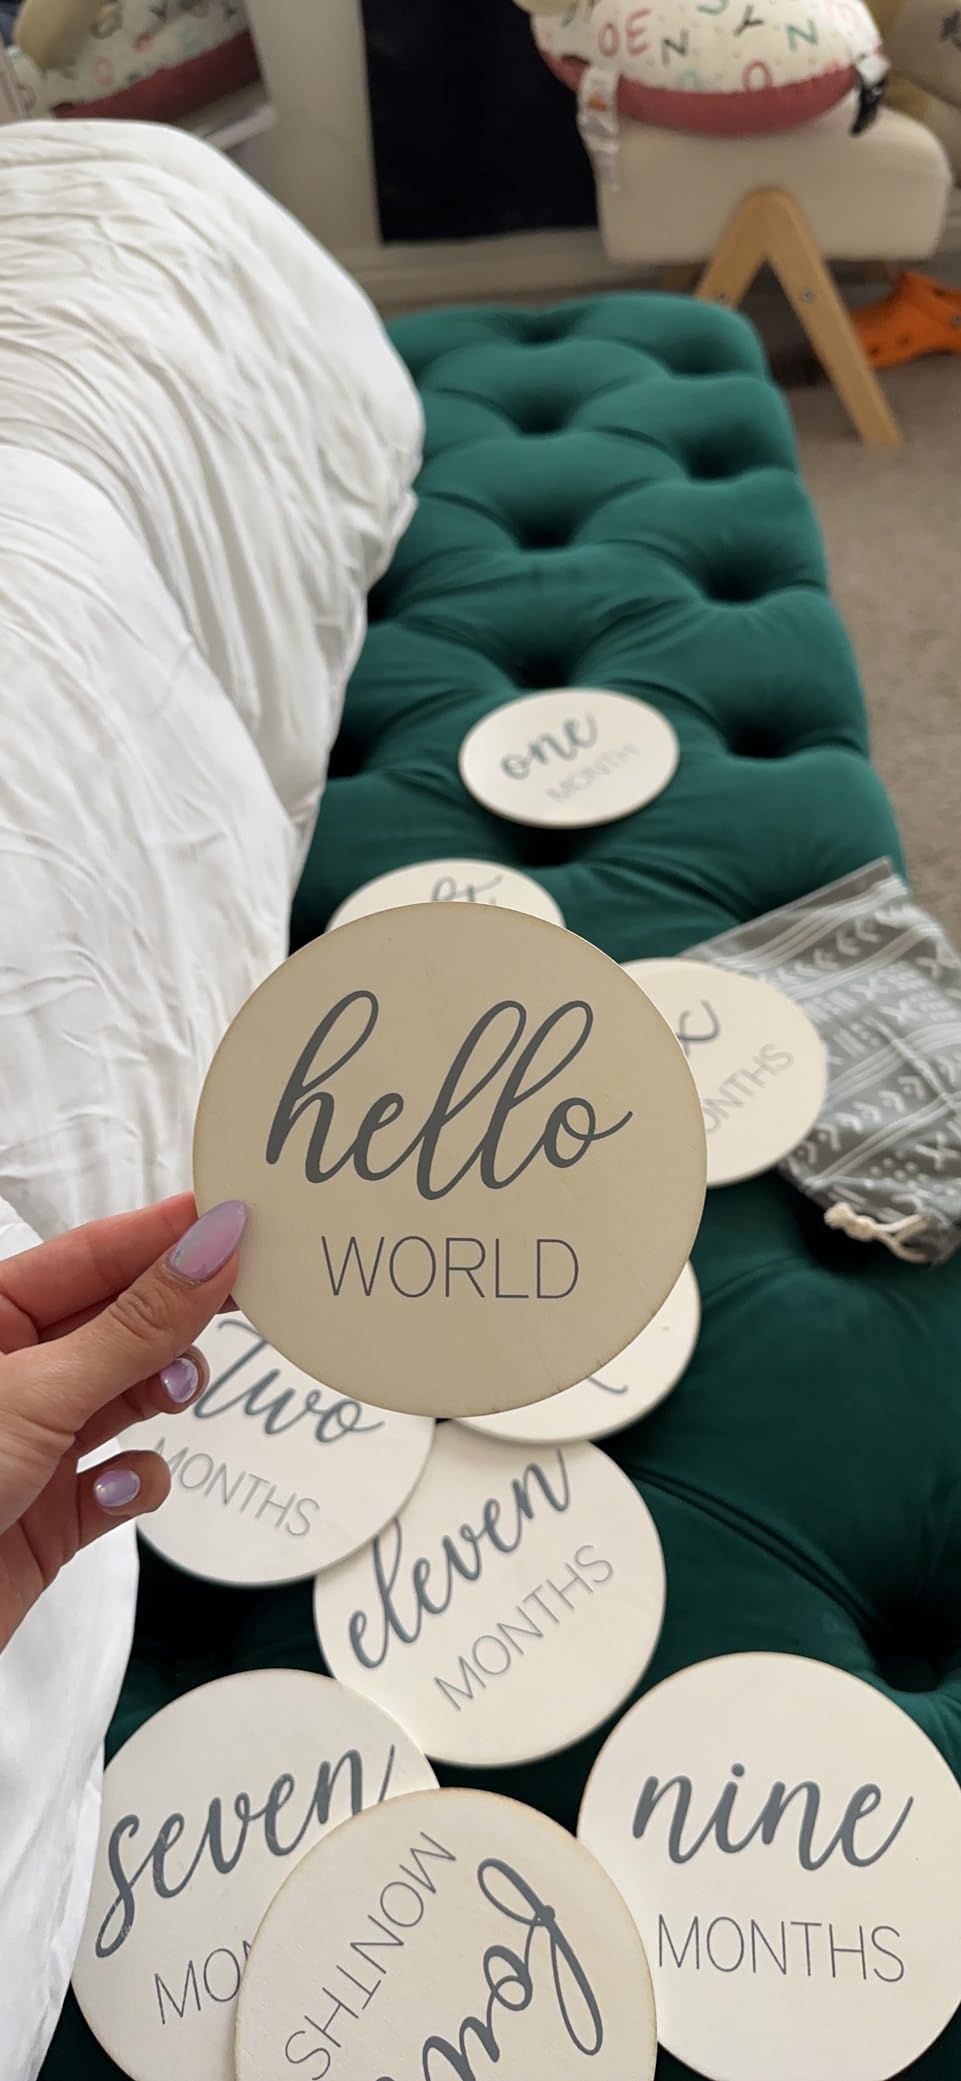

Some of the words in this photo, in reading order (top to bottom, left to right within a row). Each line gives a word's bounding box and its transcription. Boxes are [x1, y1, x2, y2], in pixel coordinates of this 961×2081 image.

[500, 711, 598, 780] one
[265, 989, 634, 1200] hello
[321, 1235, 580, 1299] WORLD
[348, 1447, 571, 1669] eleven
[433, 1544, 614, 1711] MONTHS
[95, 1743, 396, 1958] seven
[632, 1762, 915, 1871] nine
[285, 1831, 457, 2080] MONTHS
[658, 1913, 905, 1983] MONTHS
